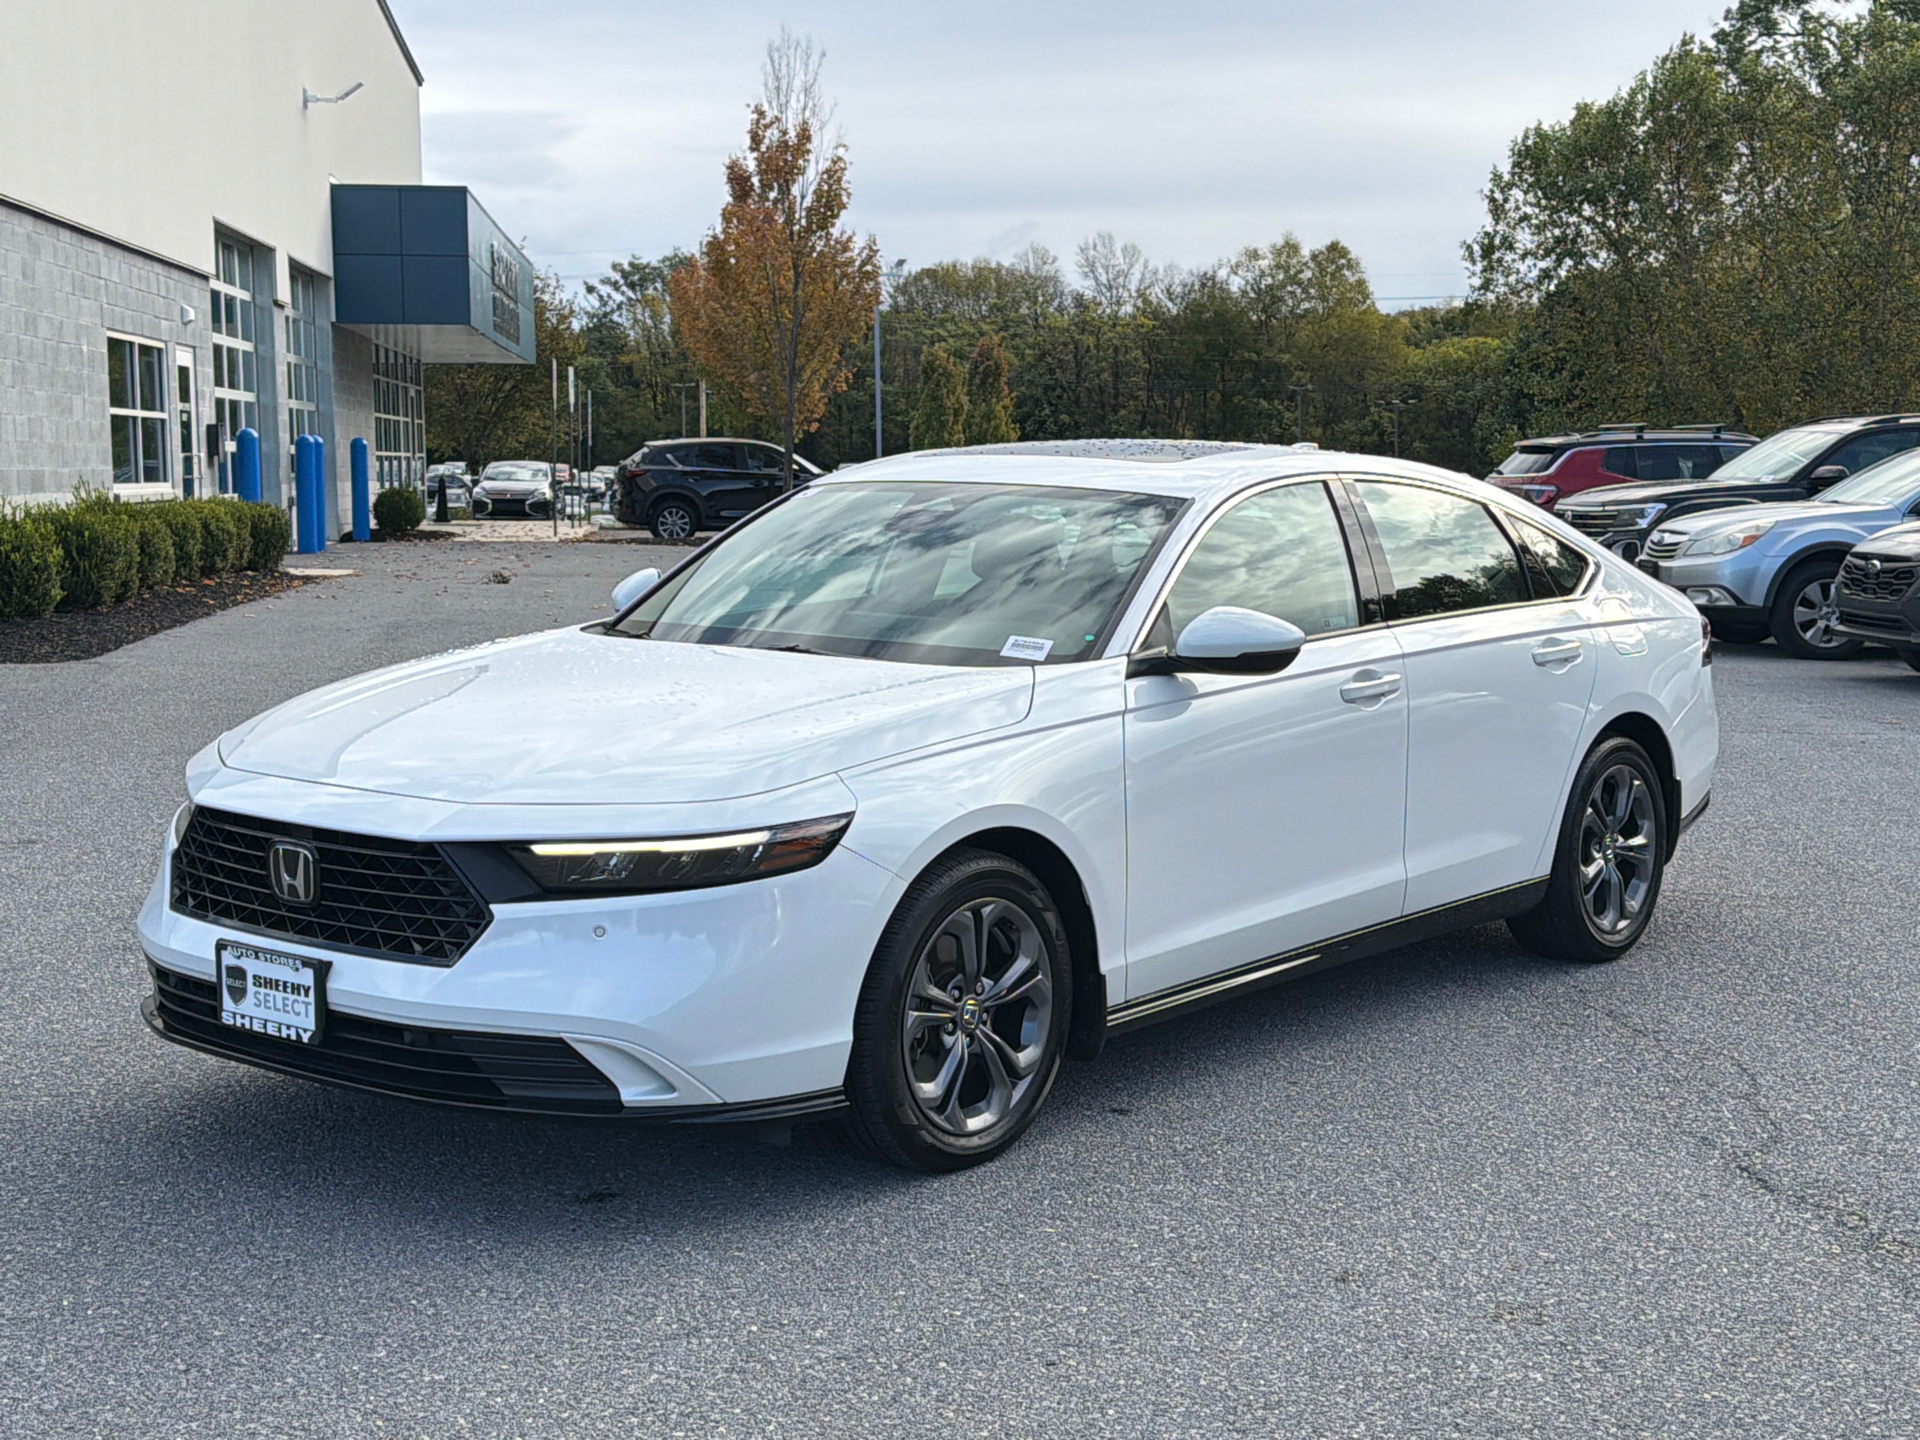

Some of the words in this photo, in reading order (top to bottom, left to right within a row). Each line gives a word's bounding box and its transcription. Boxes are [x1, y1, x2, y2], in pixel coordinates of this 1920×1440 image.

[226, 945, 256, 960] AUTO
[257, 952, 303, 969] STORES
[226, 977, 246, 989] SELECT
[252, 973, 312, 998] SHEEHY
[252, 990, 312, 1019] SELECT
[221, 1010, 314, 1044] SHEEHY
